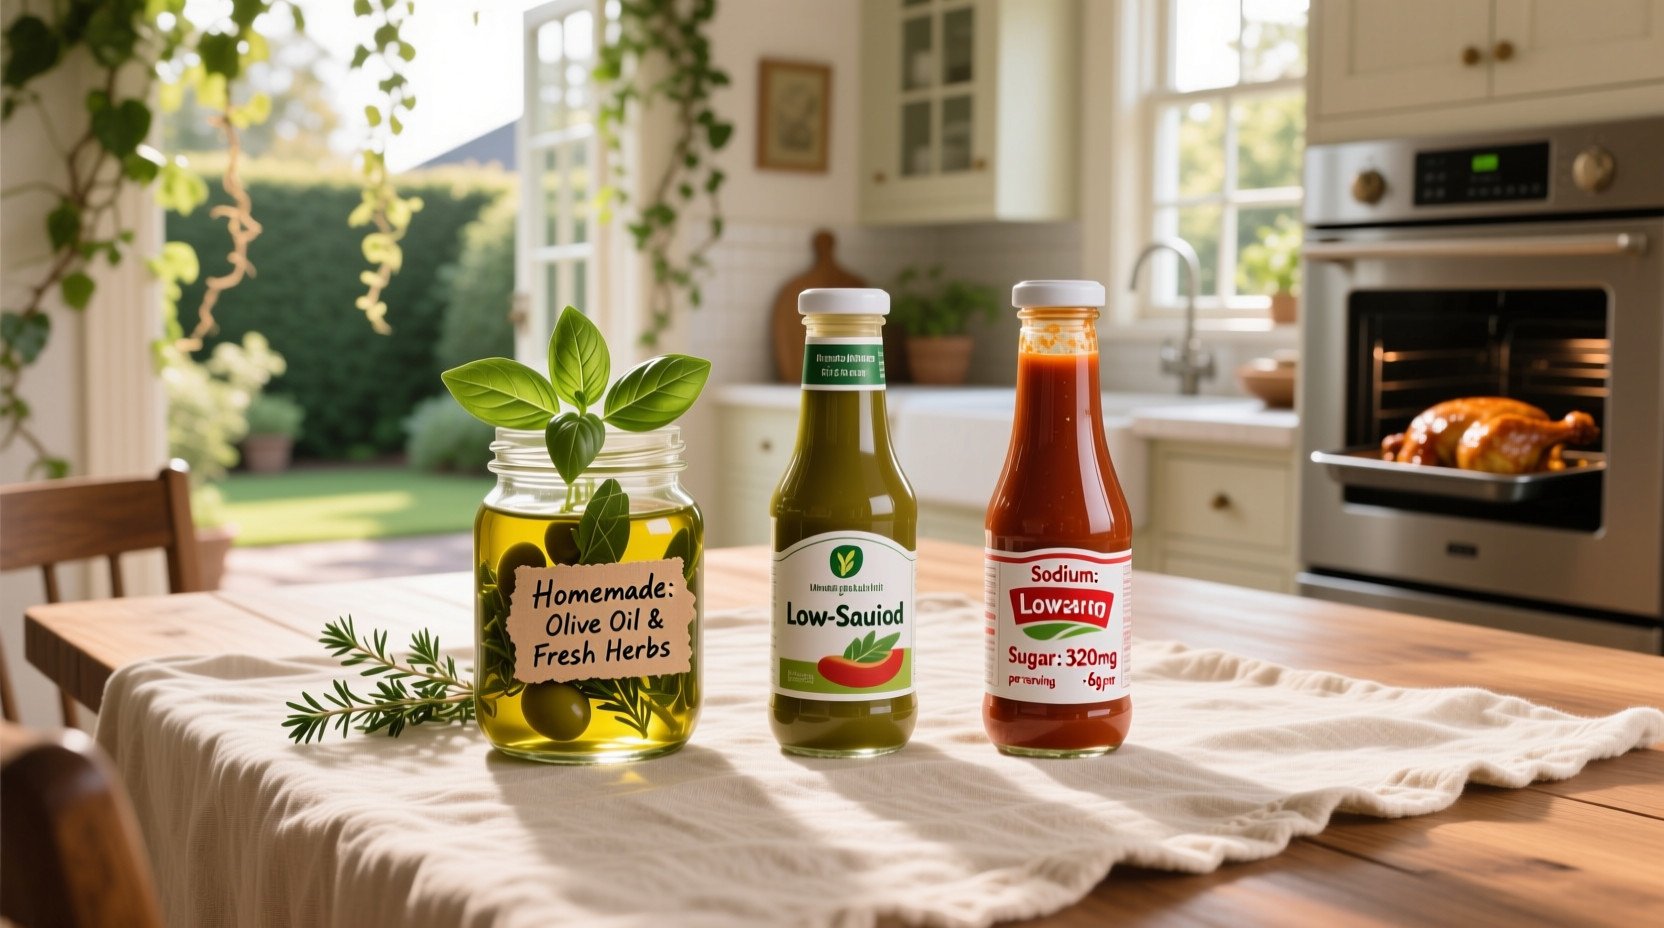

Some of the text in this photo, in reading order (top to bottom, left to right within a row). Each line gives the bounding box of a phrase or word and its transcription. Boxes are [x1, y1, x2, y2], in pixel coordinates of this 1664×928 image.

[1031, 565, 1098, 583] Sodium:
[532, 572, 674, 609] Homemade:
[546, 607, 664, 636] Olive Oil &
[787, 601, 904, 627] Low-Sauiod
[534, 635, 670, 667] Fresh Herbs
[1008, 646, 1117, 670] Sugar: 320mg
